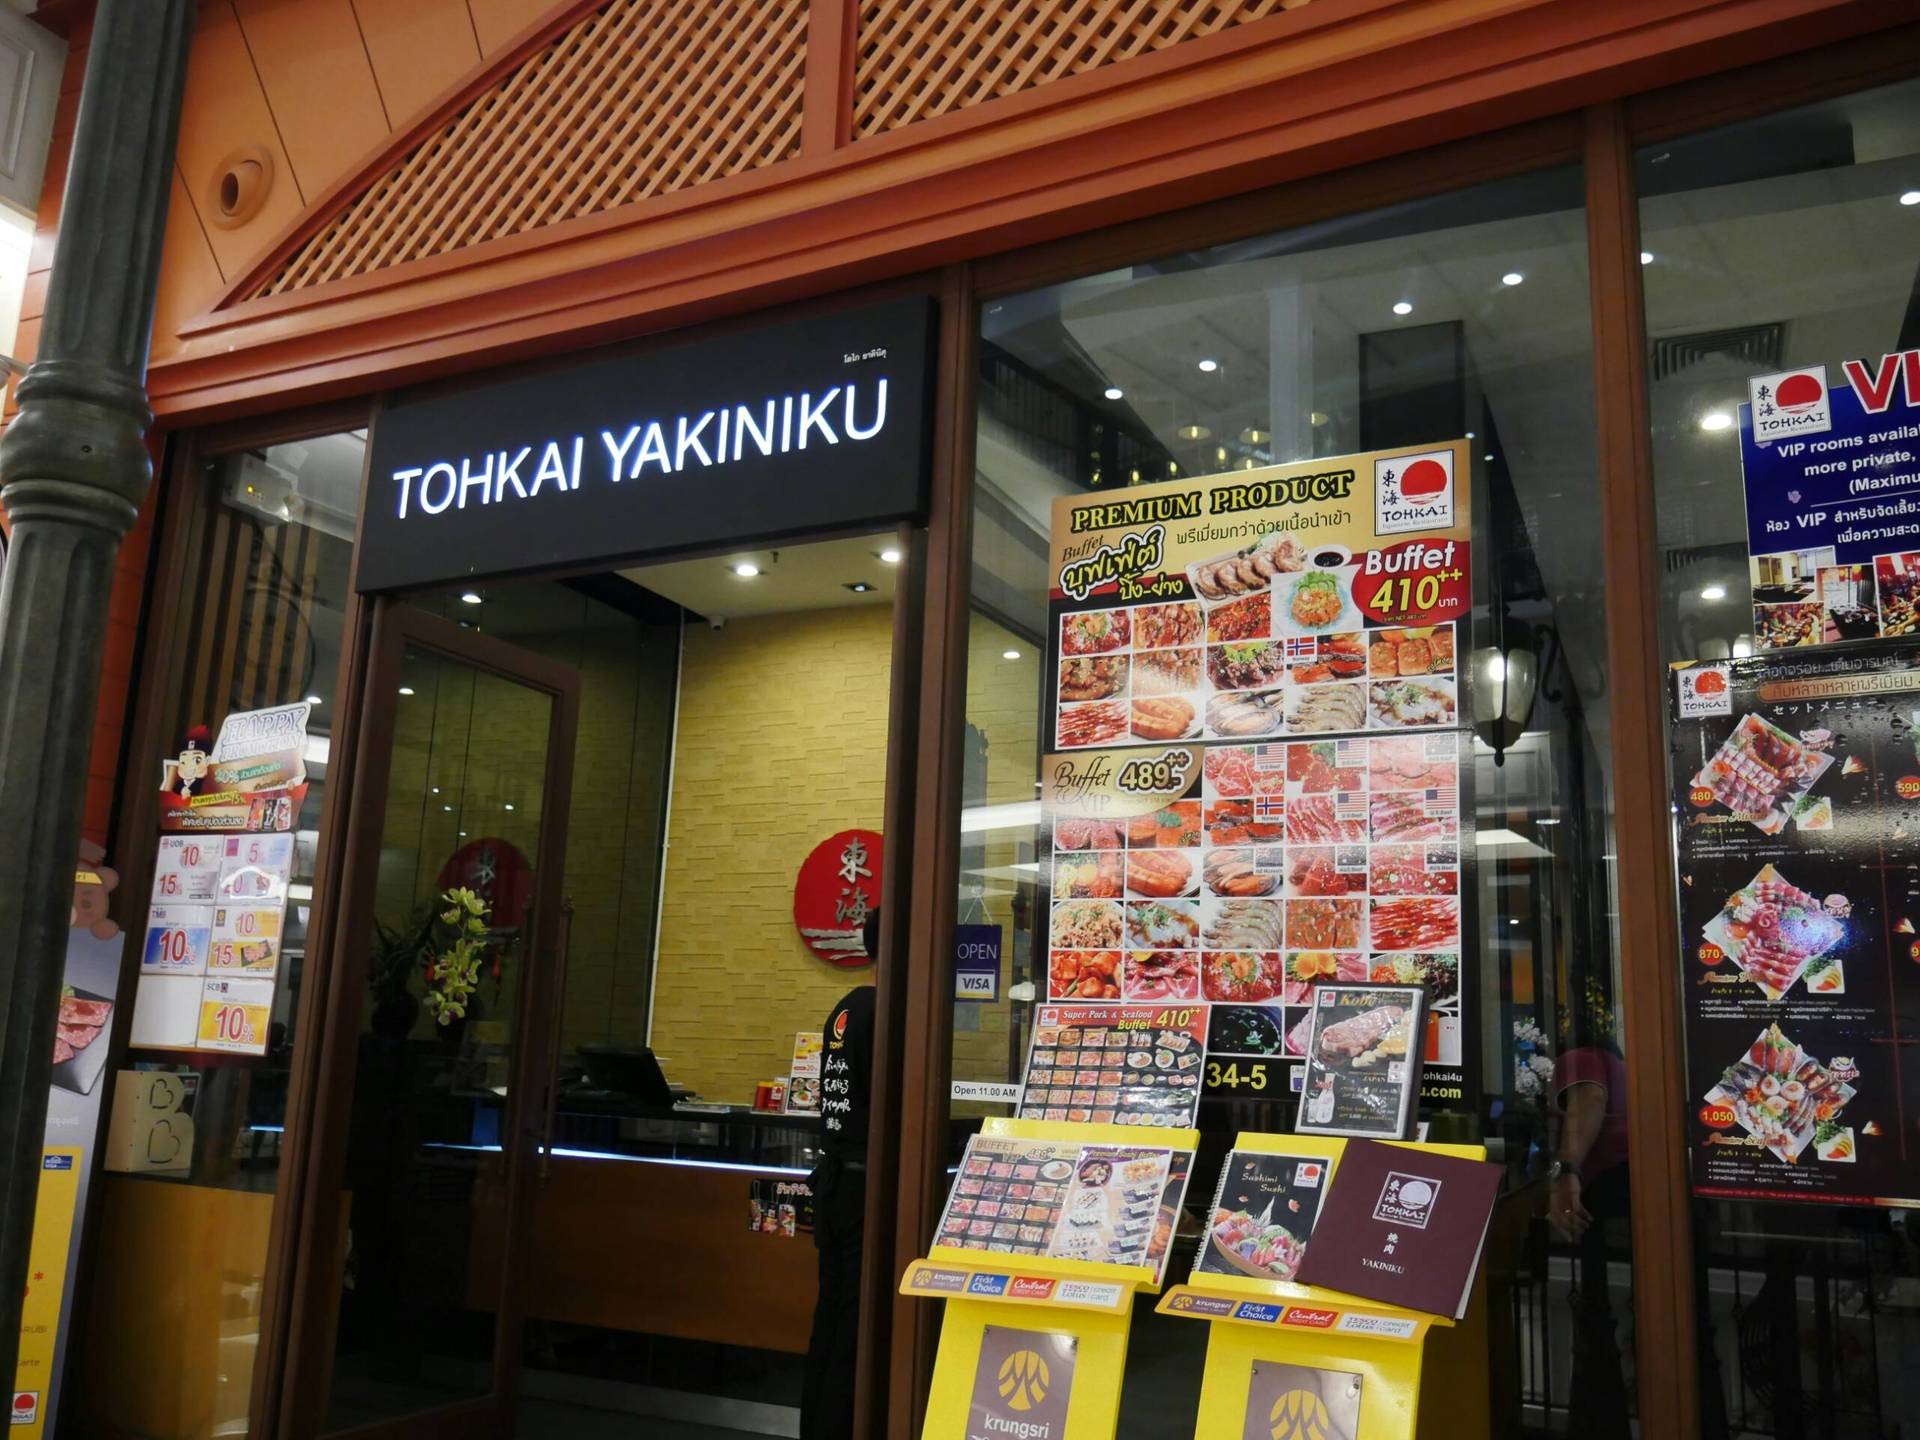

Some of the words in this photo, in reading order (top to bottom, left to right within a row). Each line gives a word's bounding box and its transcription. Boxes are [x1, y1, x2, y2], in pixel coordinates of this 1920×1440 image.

[1759, 411, 1825, 431] TOHKAI
[1777, 443, 1806, 458] VIP
[1810, 435, 1864, 453] rooms
[1868, 424, 1920, 444] availa
[393, 436, 583, 519] TOHKAI
[601, 379, 888, 482] YAKINIKU
[1804, 461, 1847, 476] more
[1852, 450, 1916, 472] private,
[1071, 491, 1202, 533] PREMIUM
[1209, 470, 1355, 515] PRODUCT
[1382, 504, 1449, 522] TOHKAI
[1766, 519, 1790, 533] ห้อง
[1796, 512, 1827, 528] VIP
[1062, 534, 1104, 562] Buffet
[1365, 541, 1456, 576] Buffet
[1683, 700, 1728, 710] TOHKAI
[1054, 755, 1112, 801] Buffet
[957, 943, 998, 960] OPEN
[962, 977, 990, 990] VISA
[1063, 1010, 1086, 1020] Super
[1089, 1009, 1108, 1019] Pork
[1121, 1010, 1152, 1019] Seafood
[1117, 1019, 1151, 1030] Buffet
[1206, 1062, 1267, 1090] 34-5
[954, 1085, 977, 1096] Open
[979, 1087, 1001, 1096] 11.00
[1002, 1088, 1017, 1097] AM
[1241, 1172, 1278, 1183] Sashimi
[1260, 1183, 1286, 1193] Sushi
[1381, 1204, 1426, 1219] TOHKAI
[1362, 1258, 1406, 1274] YAKINIKU
[934, 1273, 966, 1283] krungsri
[974, 1275, 994, 1284] First
[1014, 1279, 1052, 1290] Central
[971, 1283, 1002, 1293] Choice
[1195, 1300, 1233, 1310] krungsri
[1243, 1303, 1266, 1312] First
[1239, 1310, 1274, 1320] Choice
[1288, 1309, 1334, 1322] Central
[983, 1413, 1050, 1439] krungsri
